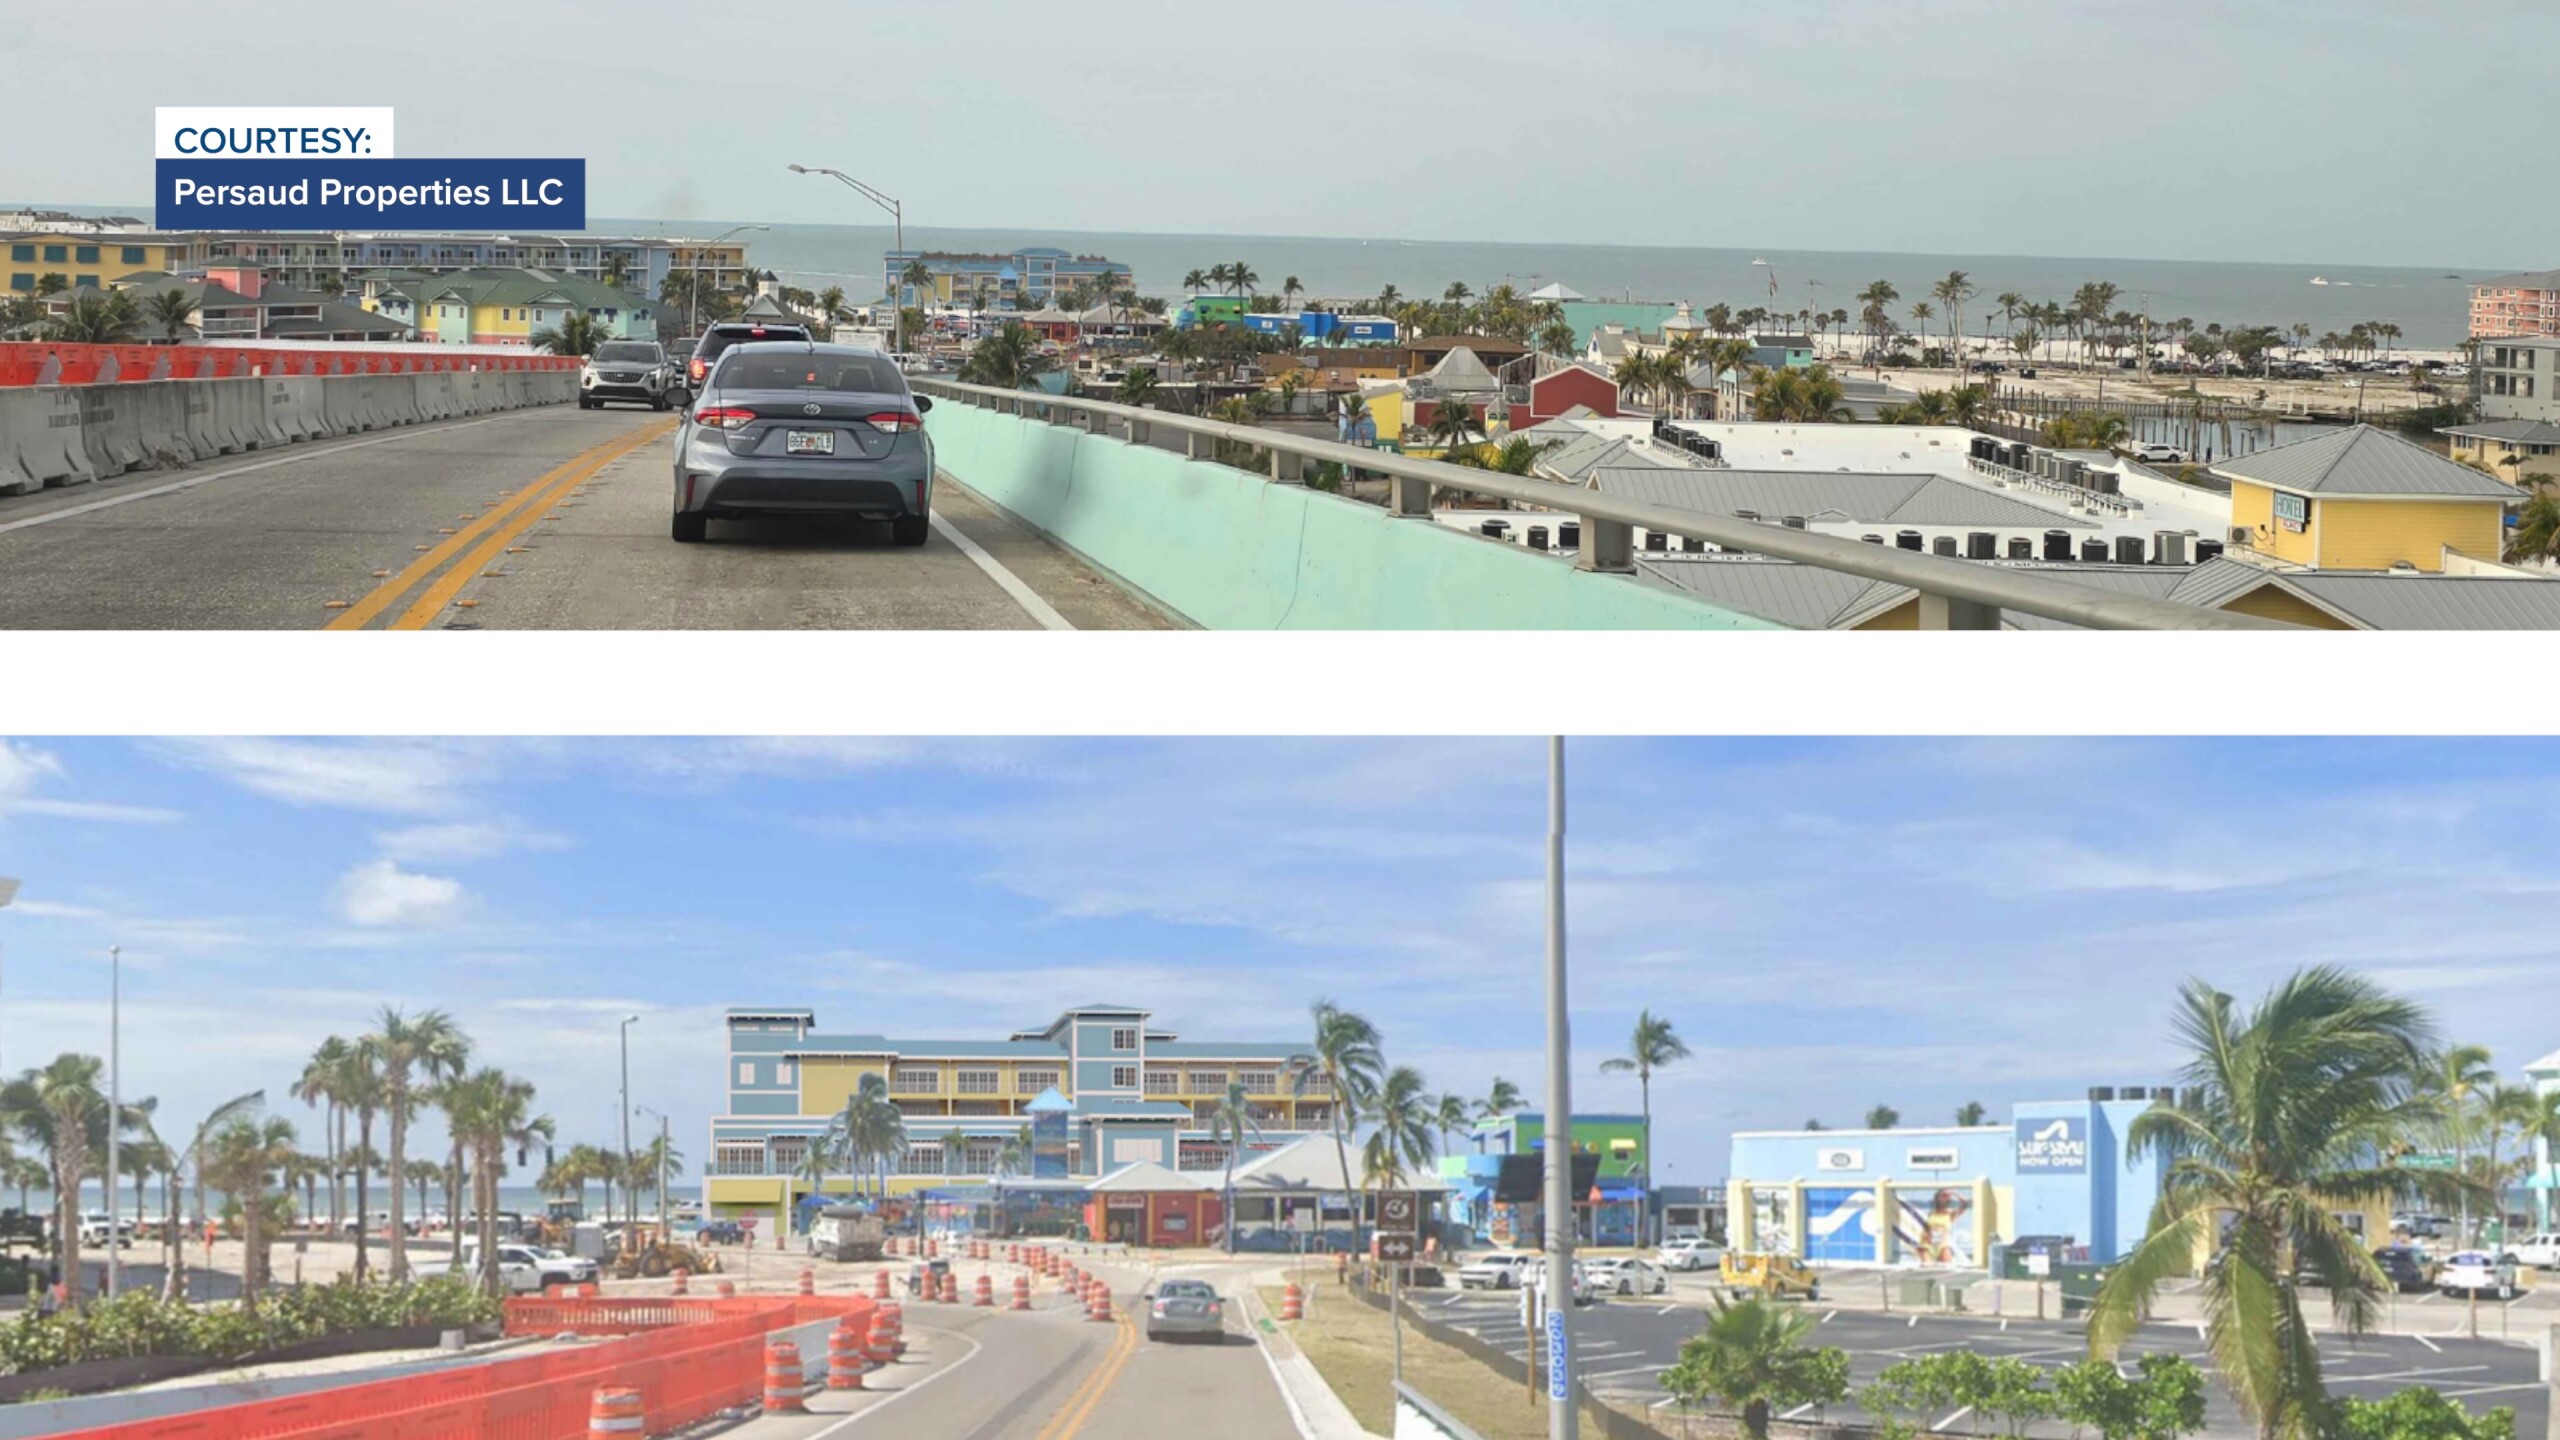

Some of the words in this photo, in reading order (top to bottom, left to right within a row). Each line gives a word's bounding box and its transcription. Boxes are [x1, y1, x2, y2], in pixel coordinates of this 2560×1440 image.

[2276, 495, 2303, 518] HOTEL
[2019, 1156, 2049, 1166] NOW
[2051, 1156, 2083, 1167] OPEN
